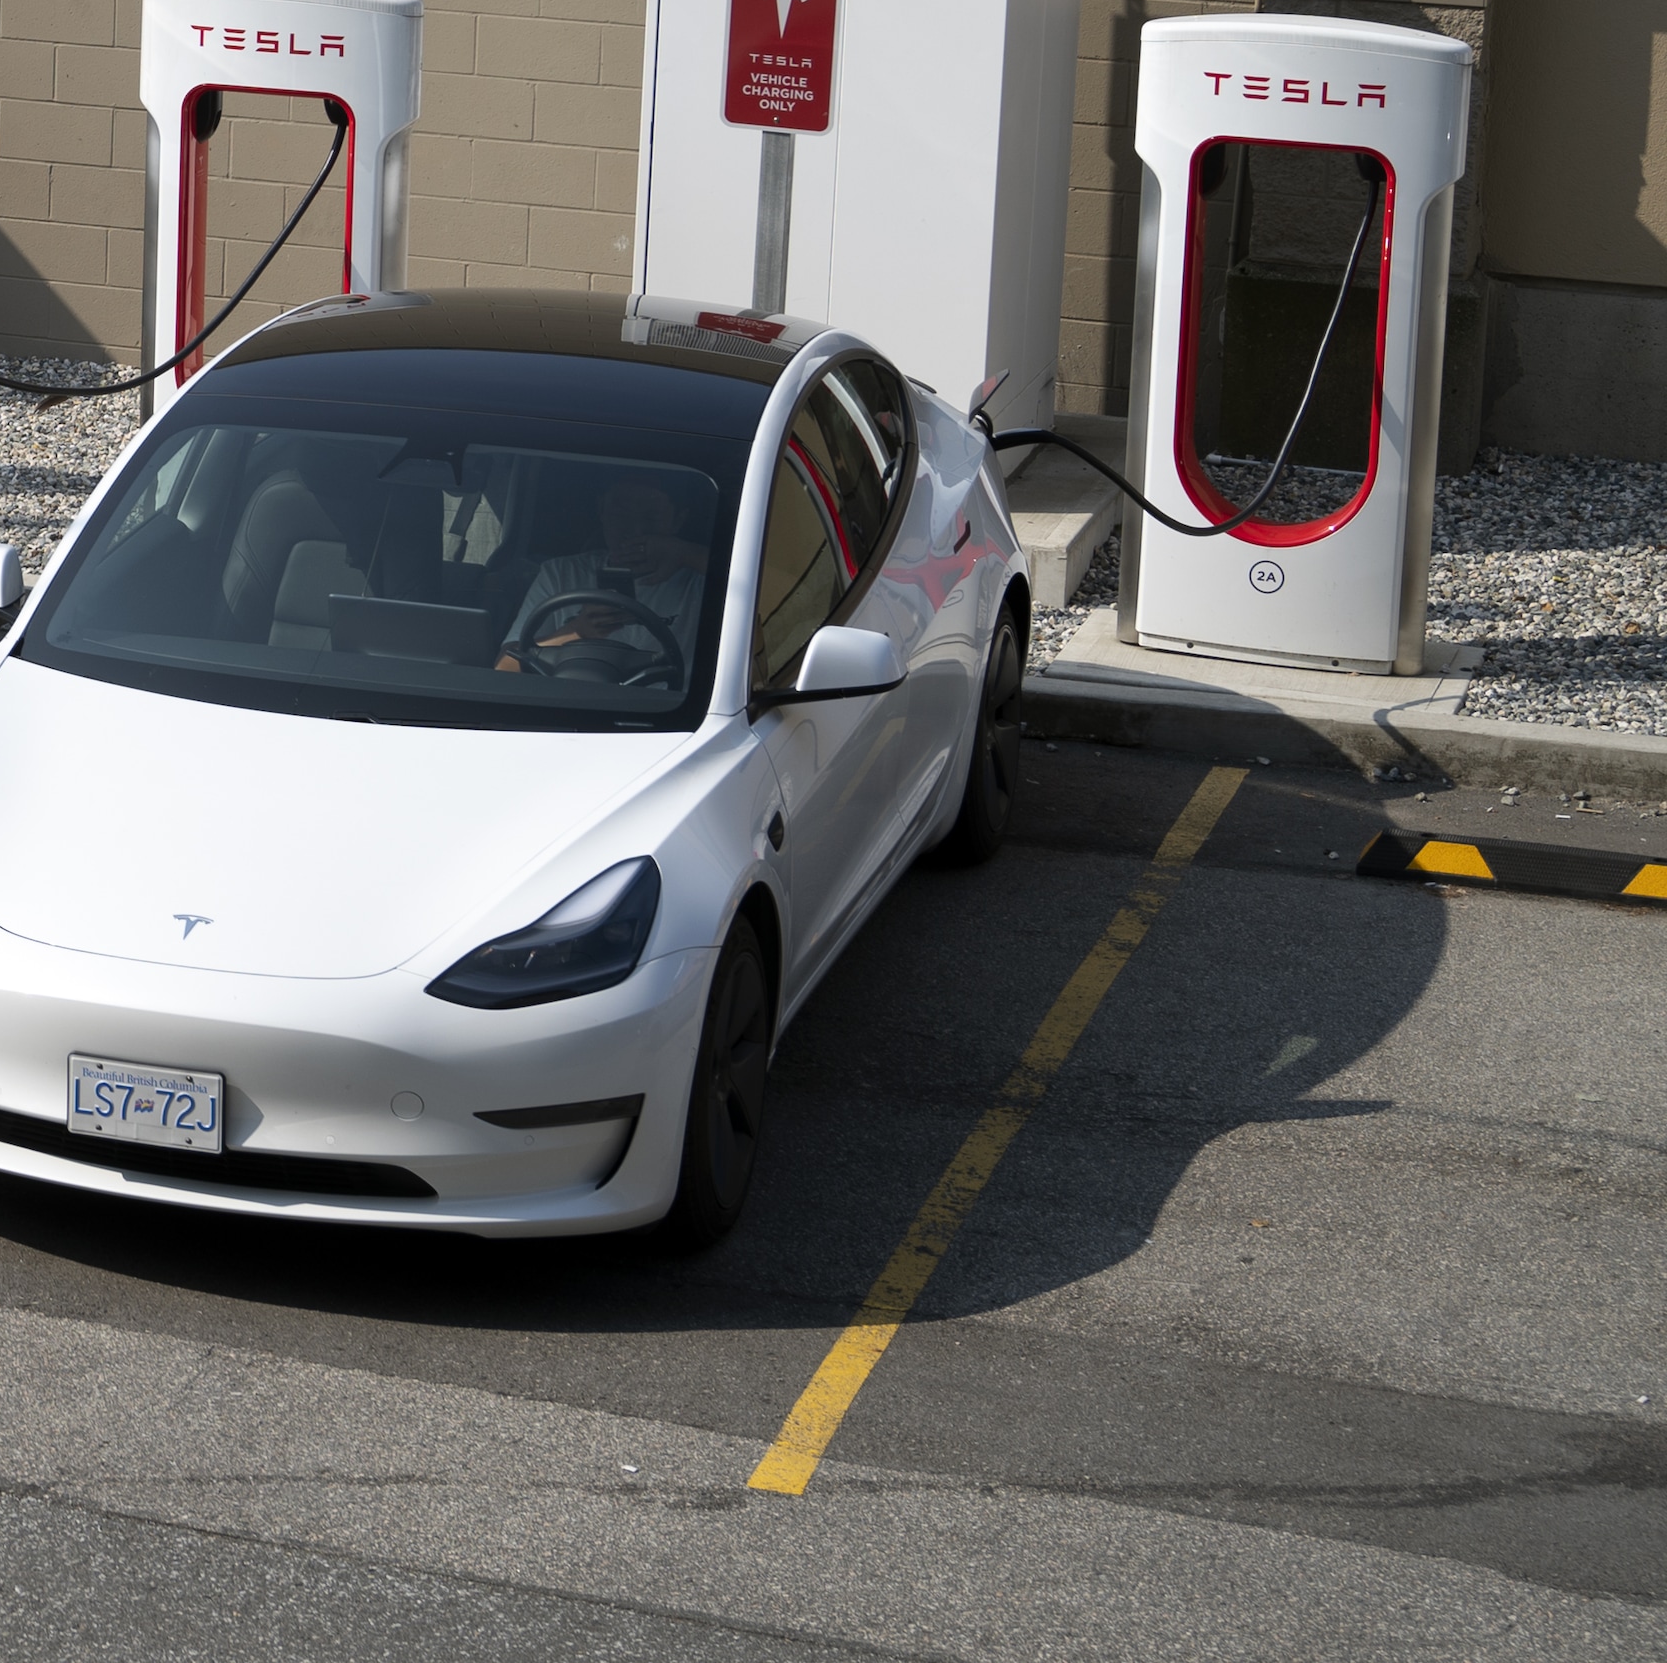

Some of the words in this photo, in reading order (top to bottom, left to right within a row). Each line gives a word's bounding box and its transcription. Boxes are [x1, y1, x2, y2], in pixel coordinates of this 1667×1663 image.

[191, 25, 345, 57] TESLA
[749, 53, 812, 69] TESLA
[750, 72, 808, 88] VEHICLE
[742, 84, 814, 101] CHARGING
[1204, 72, 1386, 108] TESLA
[759, 99, 796, 112] ONLY
[1257, 570, 1277, 583] 2A
[82, 1067, 125, 1083] Beautiful
[127, 1074, 158, 1087] British
[159, 1079, 208, 1094] Columbia
[74, 1077, 135, 1120] LS7
[155, 1089, 216, 1132] 72J
